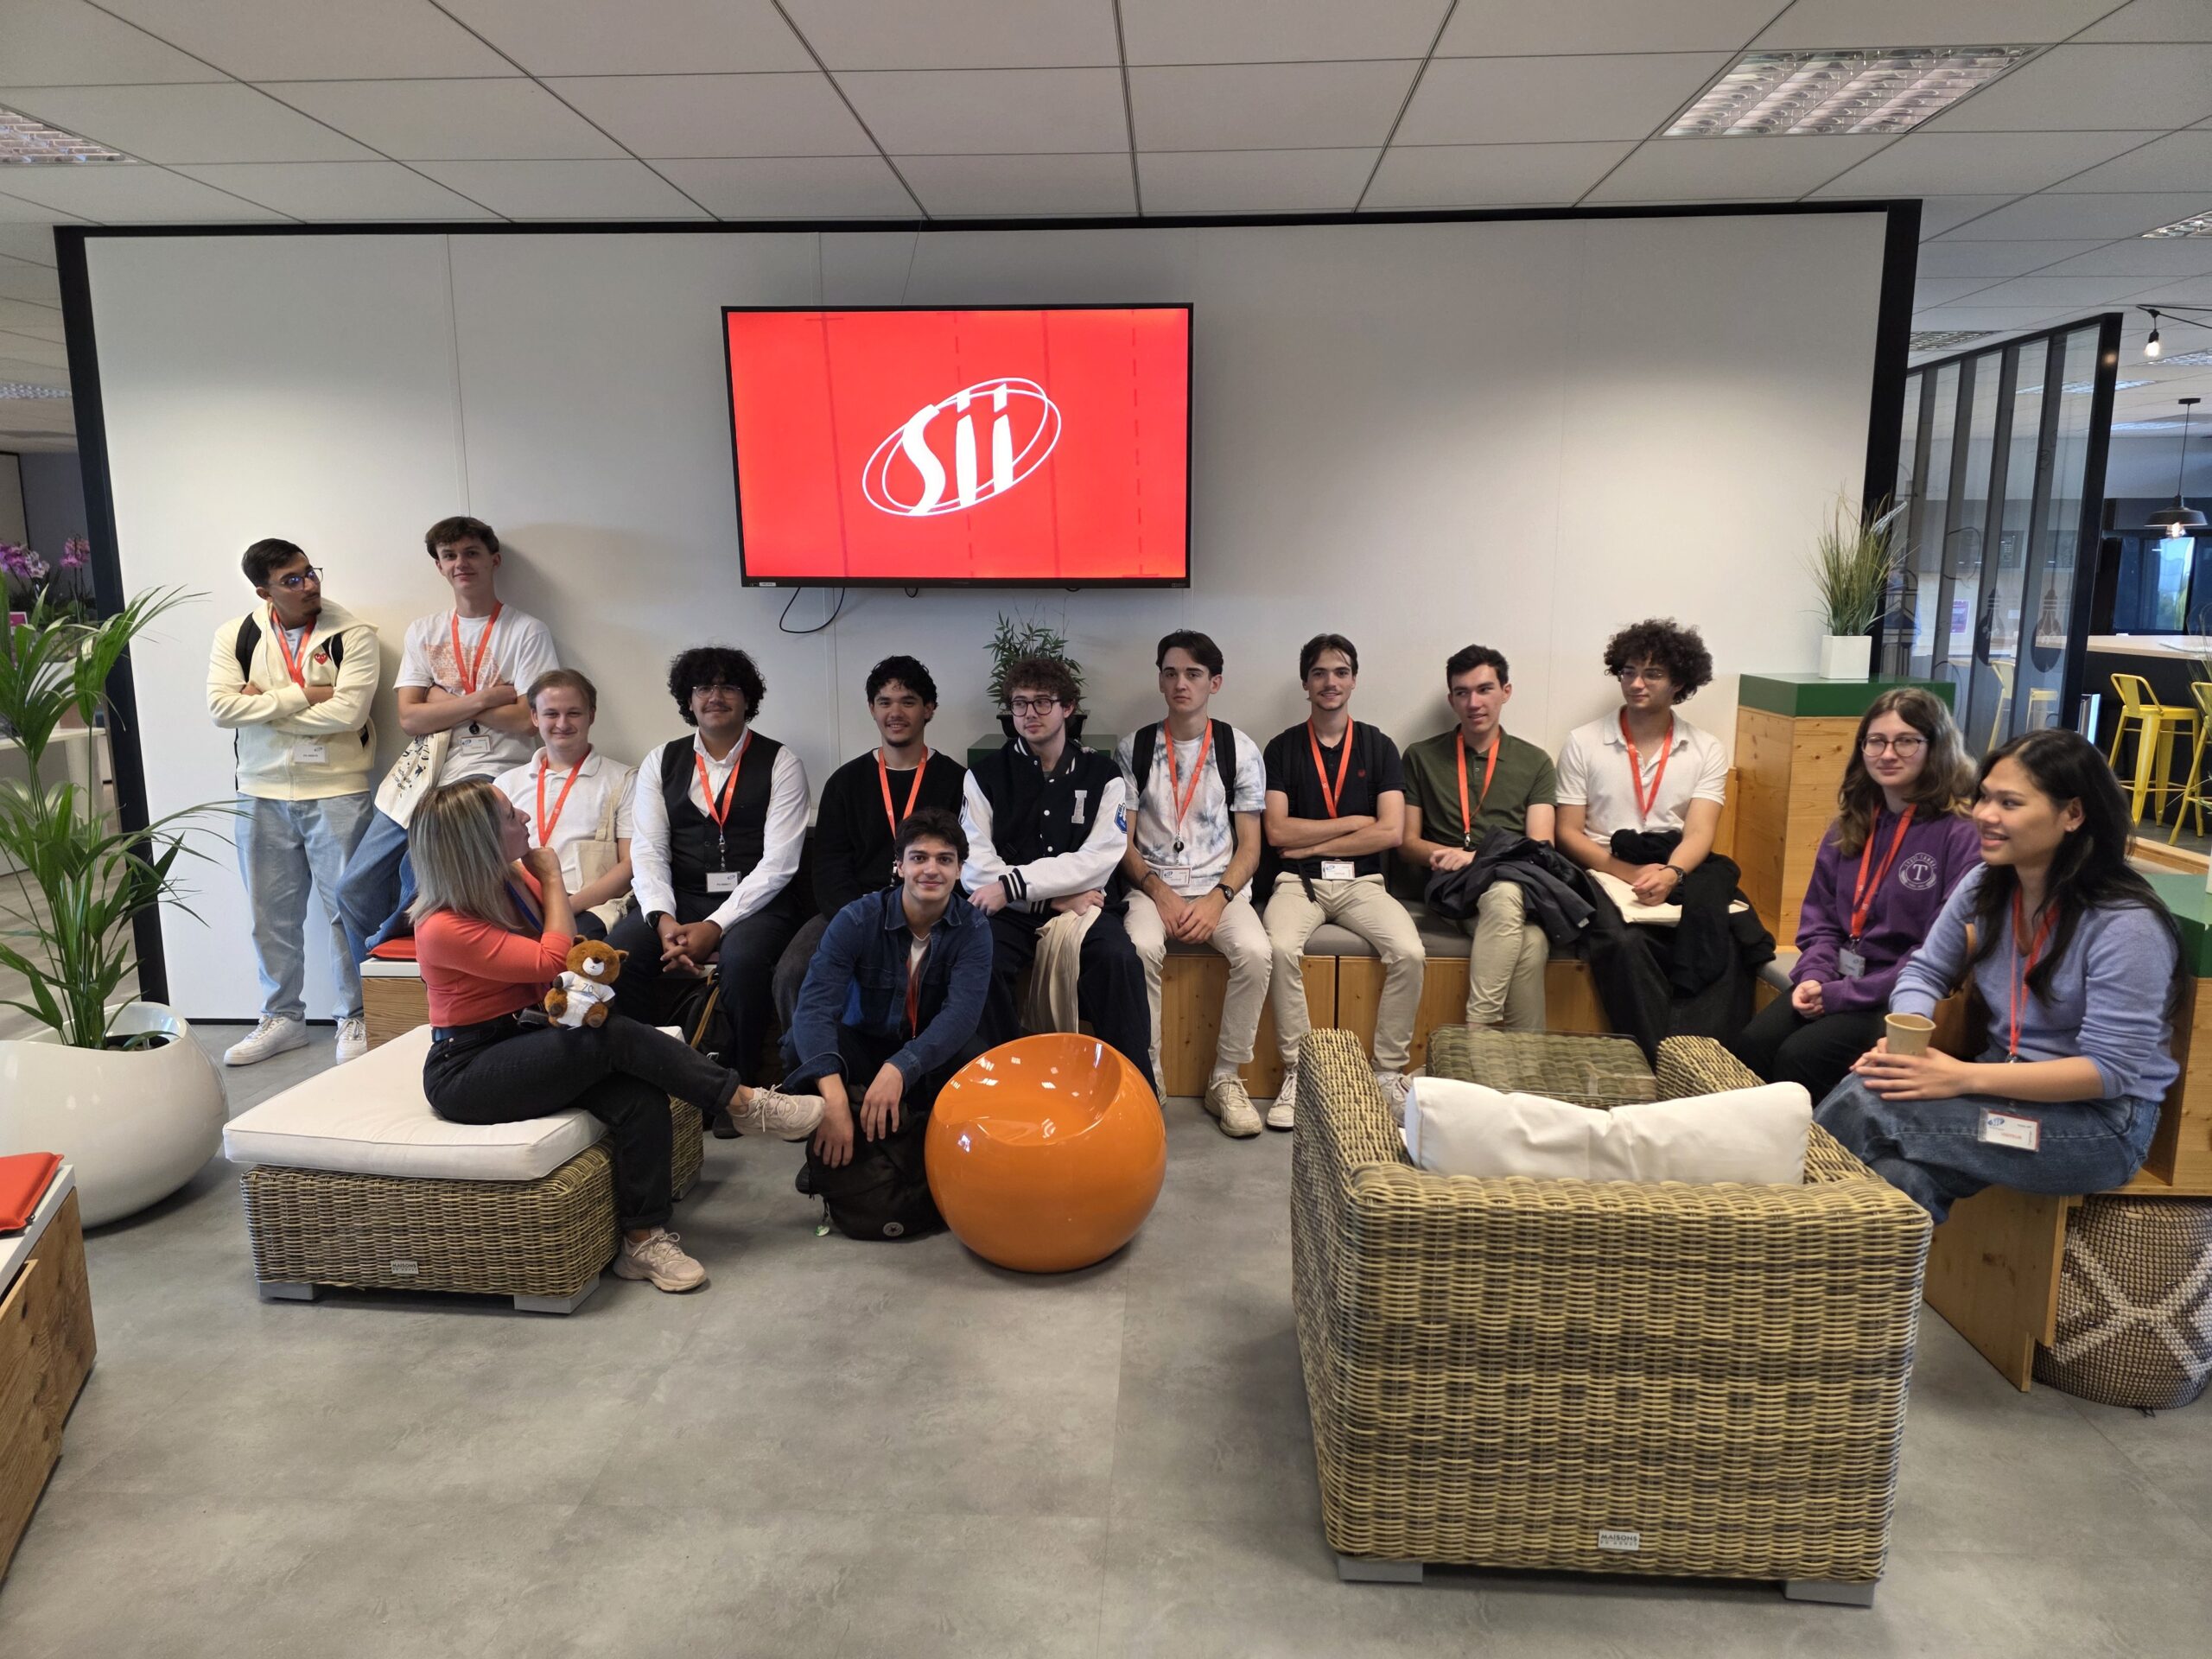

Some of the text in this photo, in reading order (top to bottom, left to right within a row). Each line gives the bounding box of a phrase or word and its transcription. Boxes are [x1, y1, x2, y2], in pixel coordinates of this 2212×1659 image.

[1071, 790, 1087, 823] I
[1912, 864, 1928, 880] T
[1600, 1534, 1638, 1542] MAISONS
